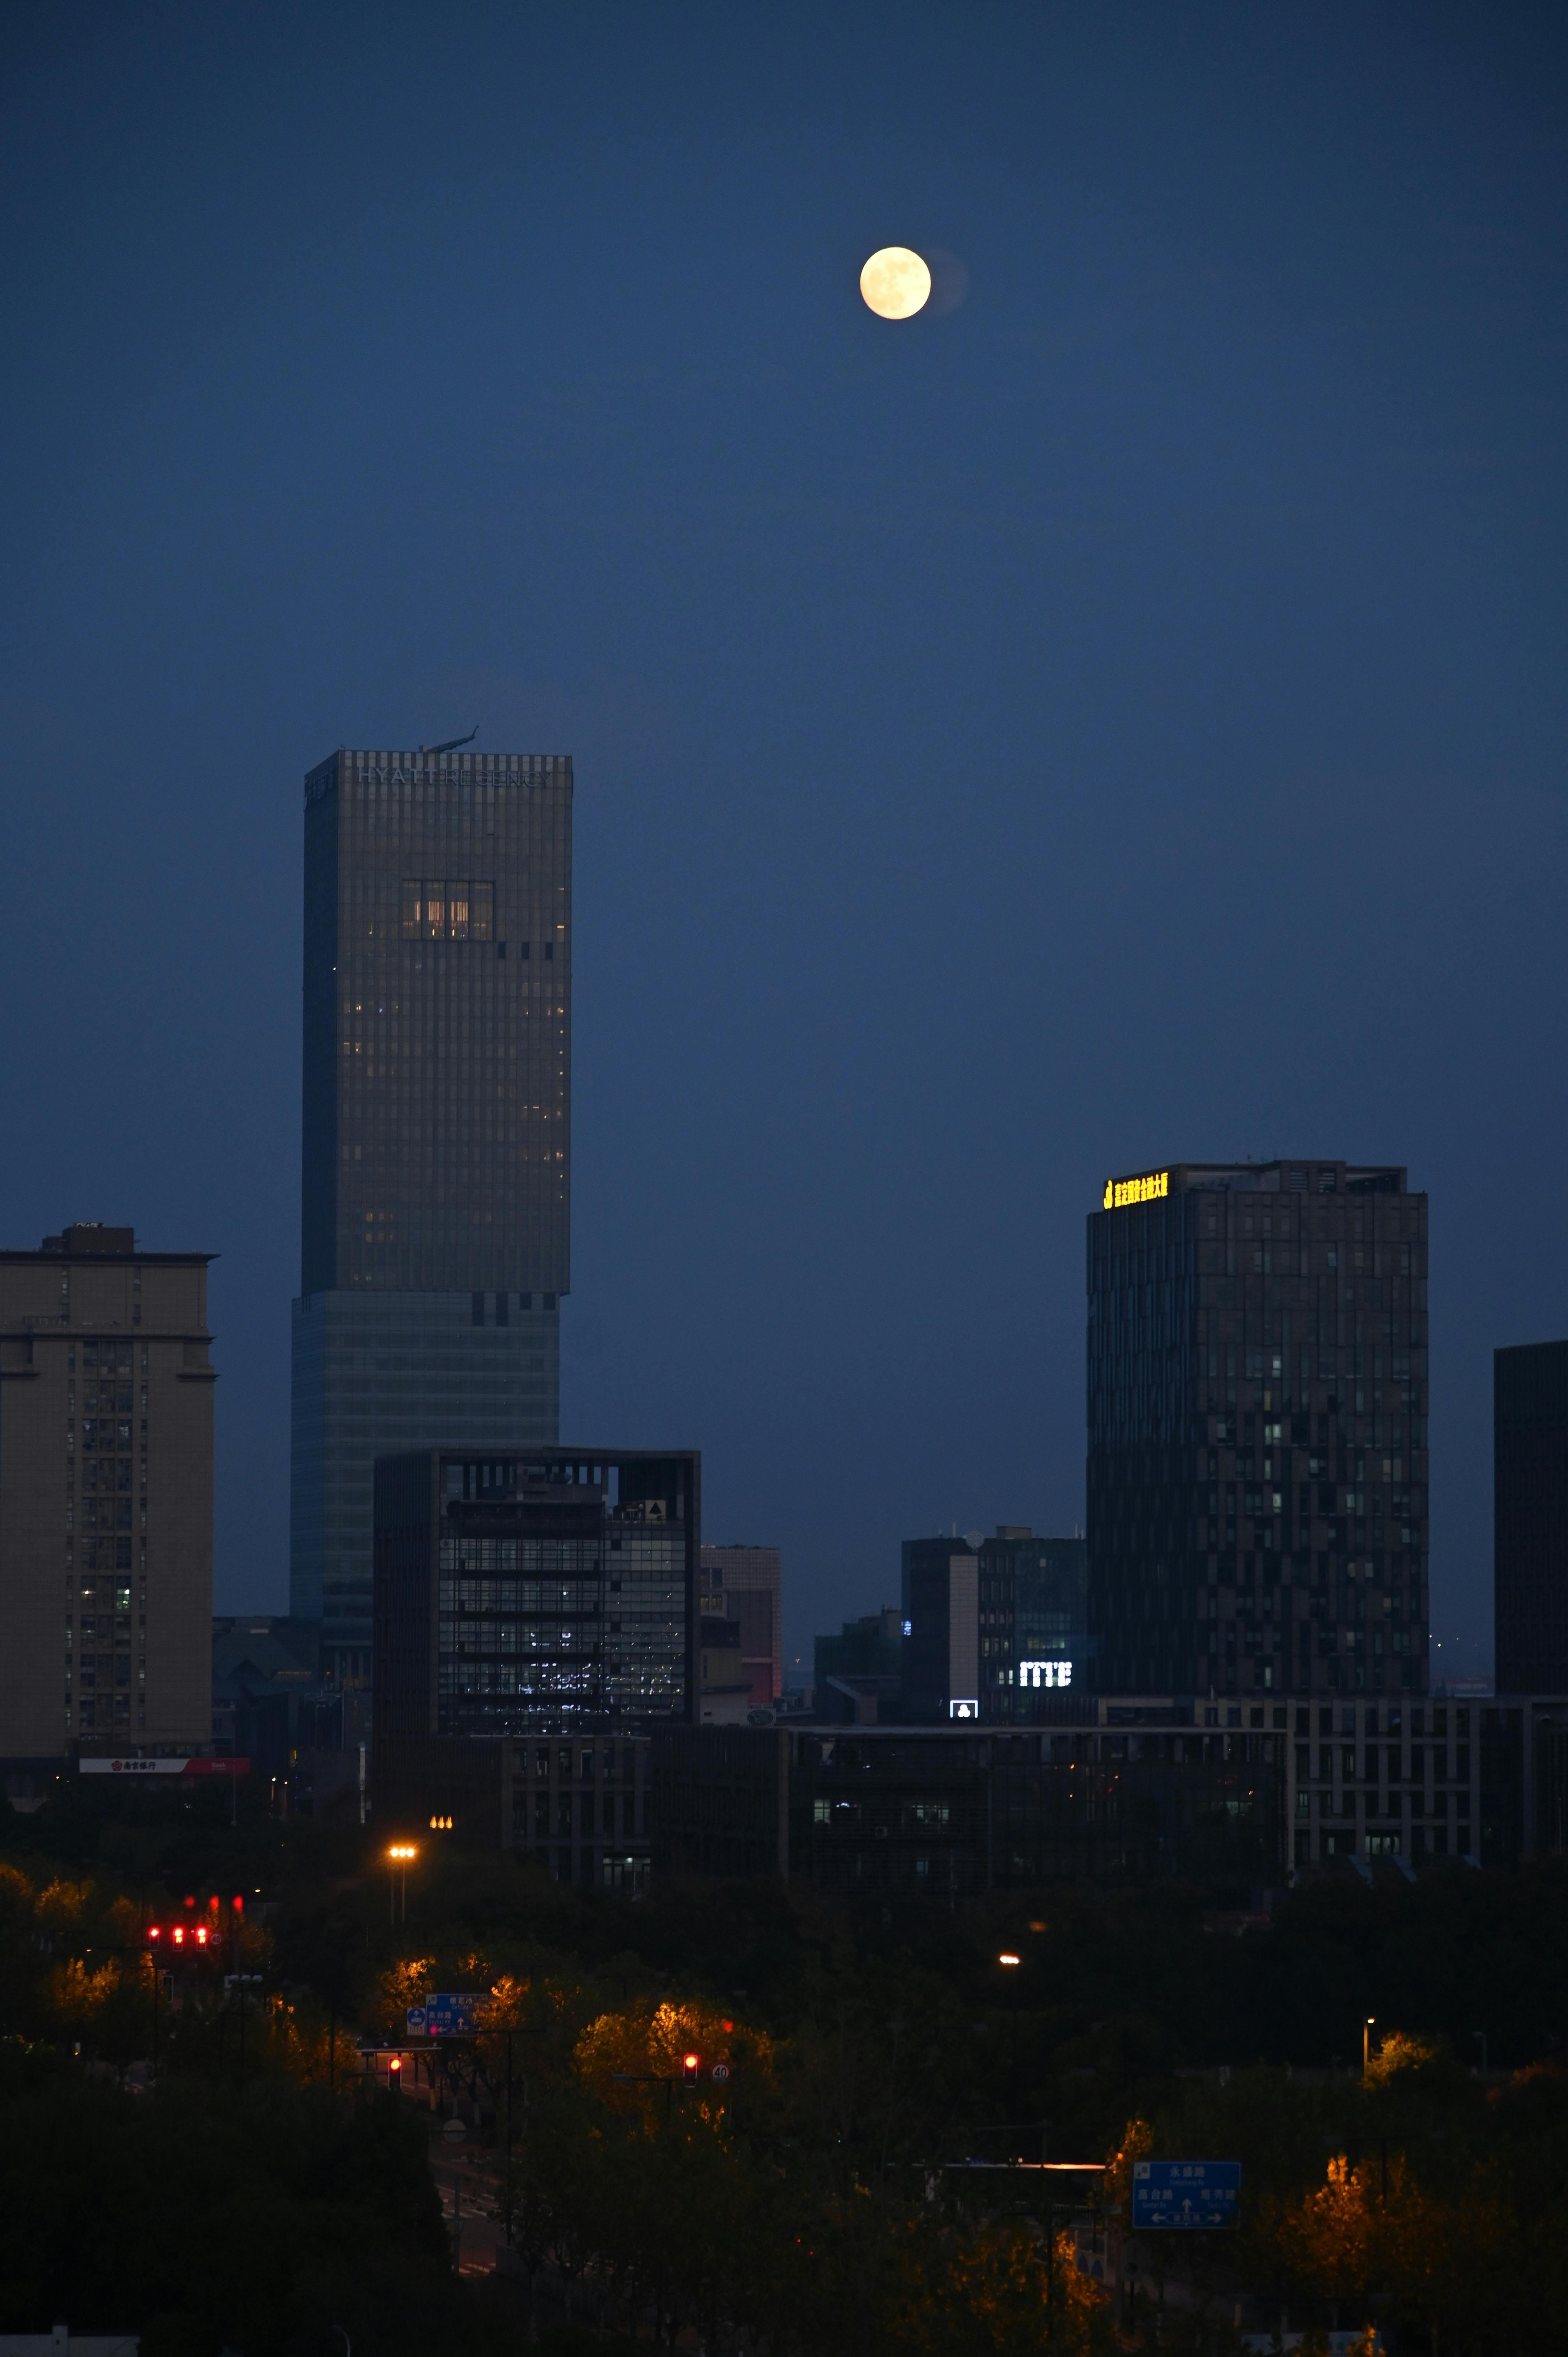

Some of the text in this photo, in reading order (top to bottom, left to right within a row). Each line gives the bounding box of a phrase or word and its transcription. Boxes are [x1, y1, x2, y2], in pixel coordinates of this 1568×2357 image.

[357, 767, 553, 787] HYATT REGENCY
[1114, 1173, 1168, 1207] 嘉定国资金融大厦
[714, 2067, 727, 2077] 40
[1170, 2165, 1205, 2177] 永盛路
[1138, 2189, 1173, 2200] 高台路
